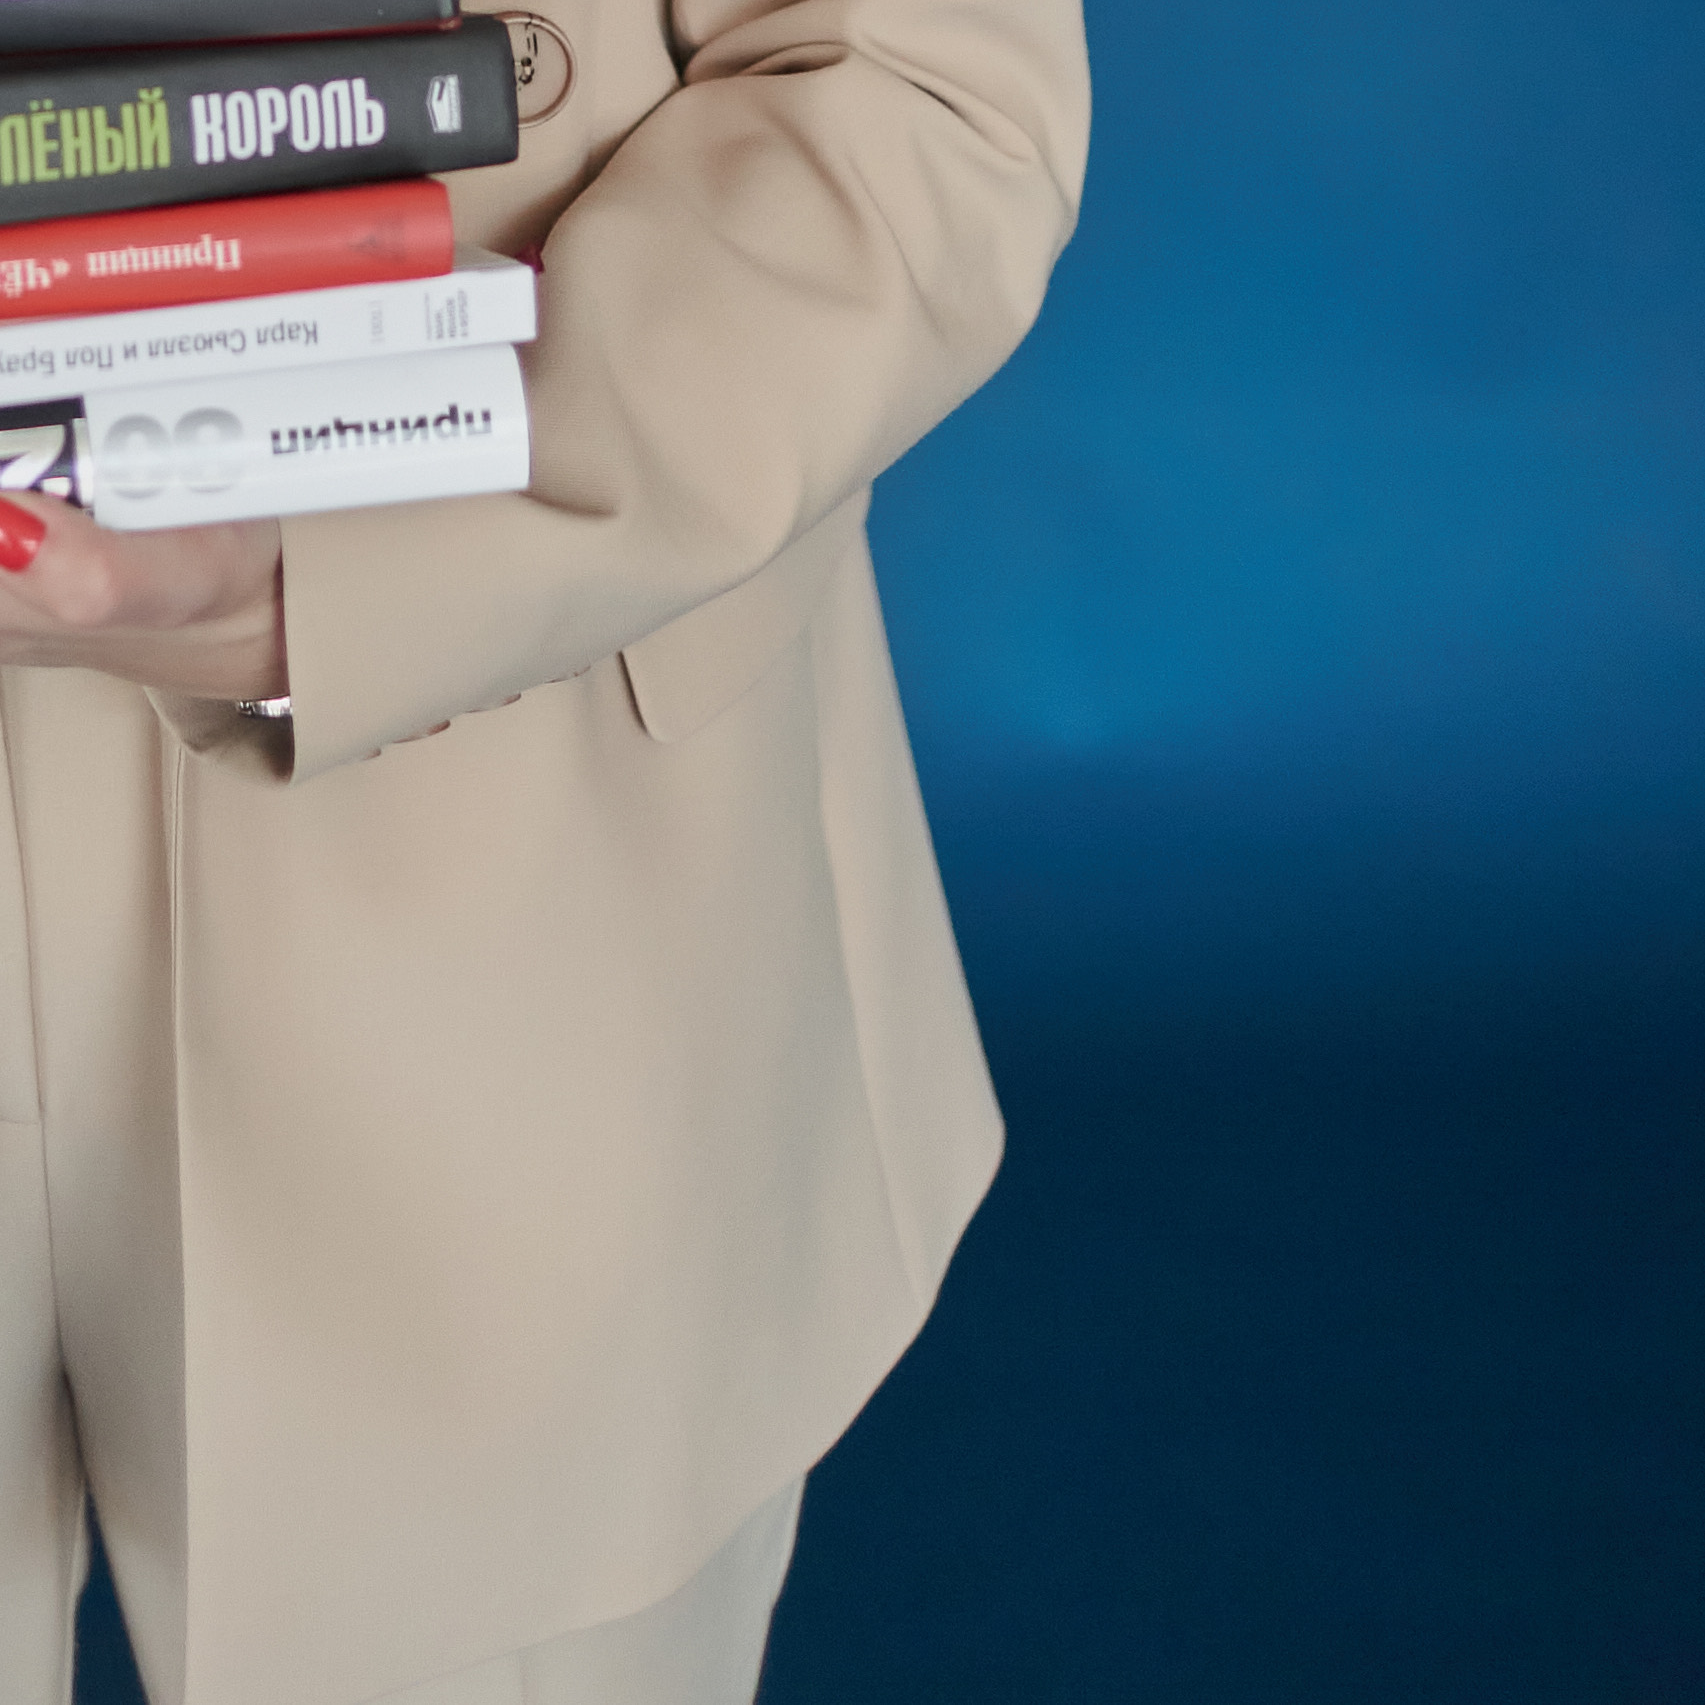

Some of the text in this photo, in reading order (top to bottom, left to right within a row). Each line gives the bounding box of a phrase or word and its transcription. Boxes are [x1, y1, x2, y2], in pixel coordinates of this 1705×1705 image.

[190, 77, 384, 164] КОРОЛЬ
[87, 238, 241, 278] Принцип
[147, 326, 246, 360] Сьюэлл
[258, 319, 319, 348] Карл
[65, 344, 114, 371] Пол
[123, 342, 137, 362] и
[270, 405, 492, 457] принцип
